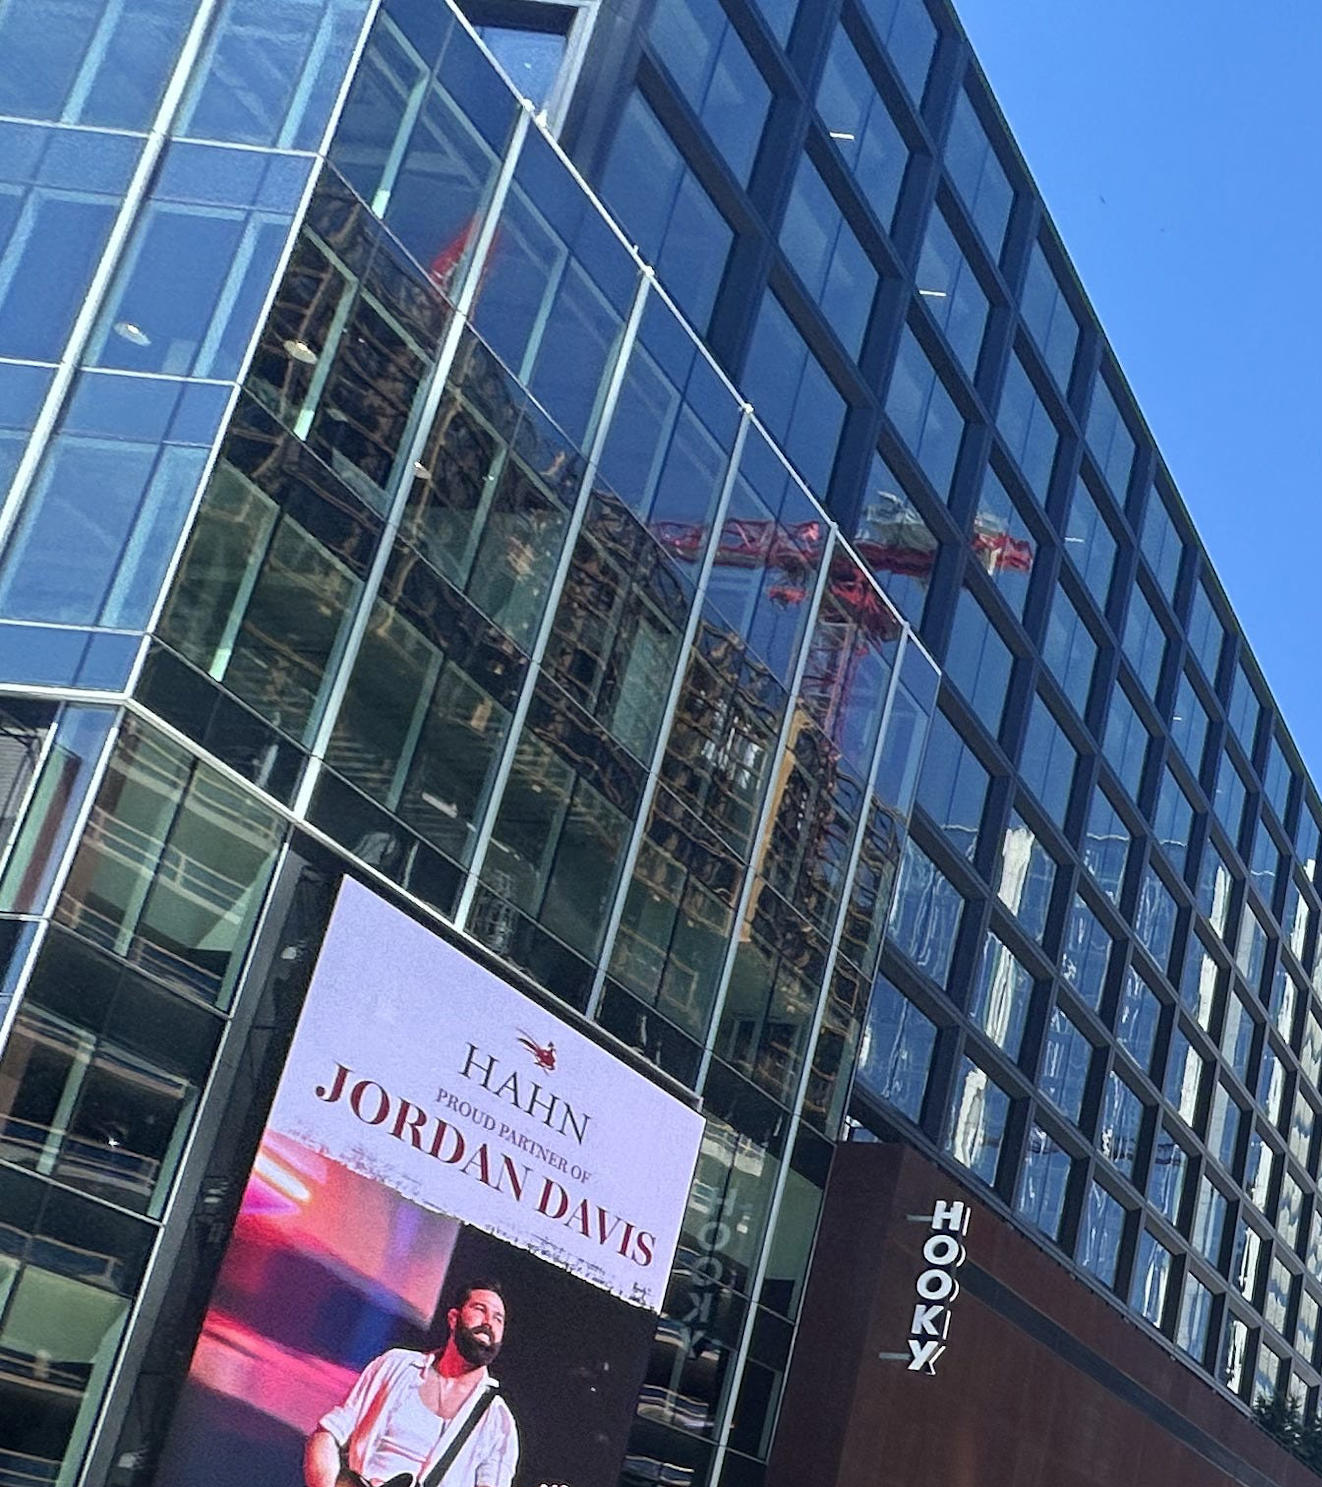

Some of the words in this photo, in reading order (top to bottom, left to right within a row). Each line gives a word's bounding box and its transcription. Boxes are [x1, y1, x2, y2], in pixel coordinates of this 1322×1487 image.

[435, 1087, 497, 1131] PROUD
[498, 1123, 569, 1174] PARTNER
[570, 1163, 593, 1185] OF
[458, 1041, 592, 1146] HAHN
[315, 1061, 533, 1202] JORDAN
[534, 1177, 657, 1267] DAVIS
[906, 1199, 971, 1375] HOOKY
